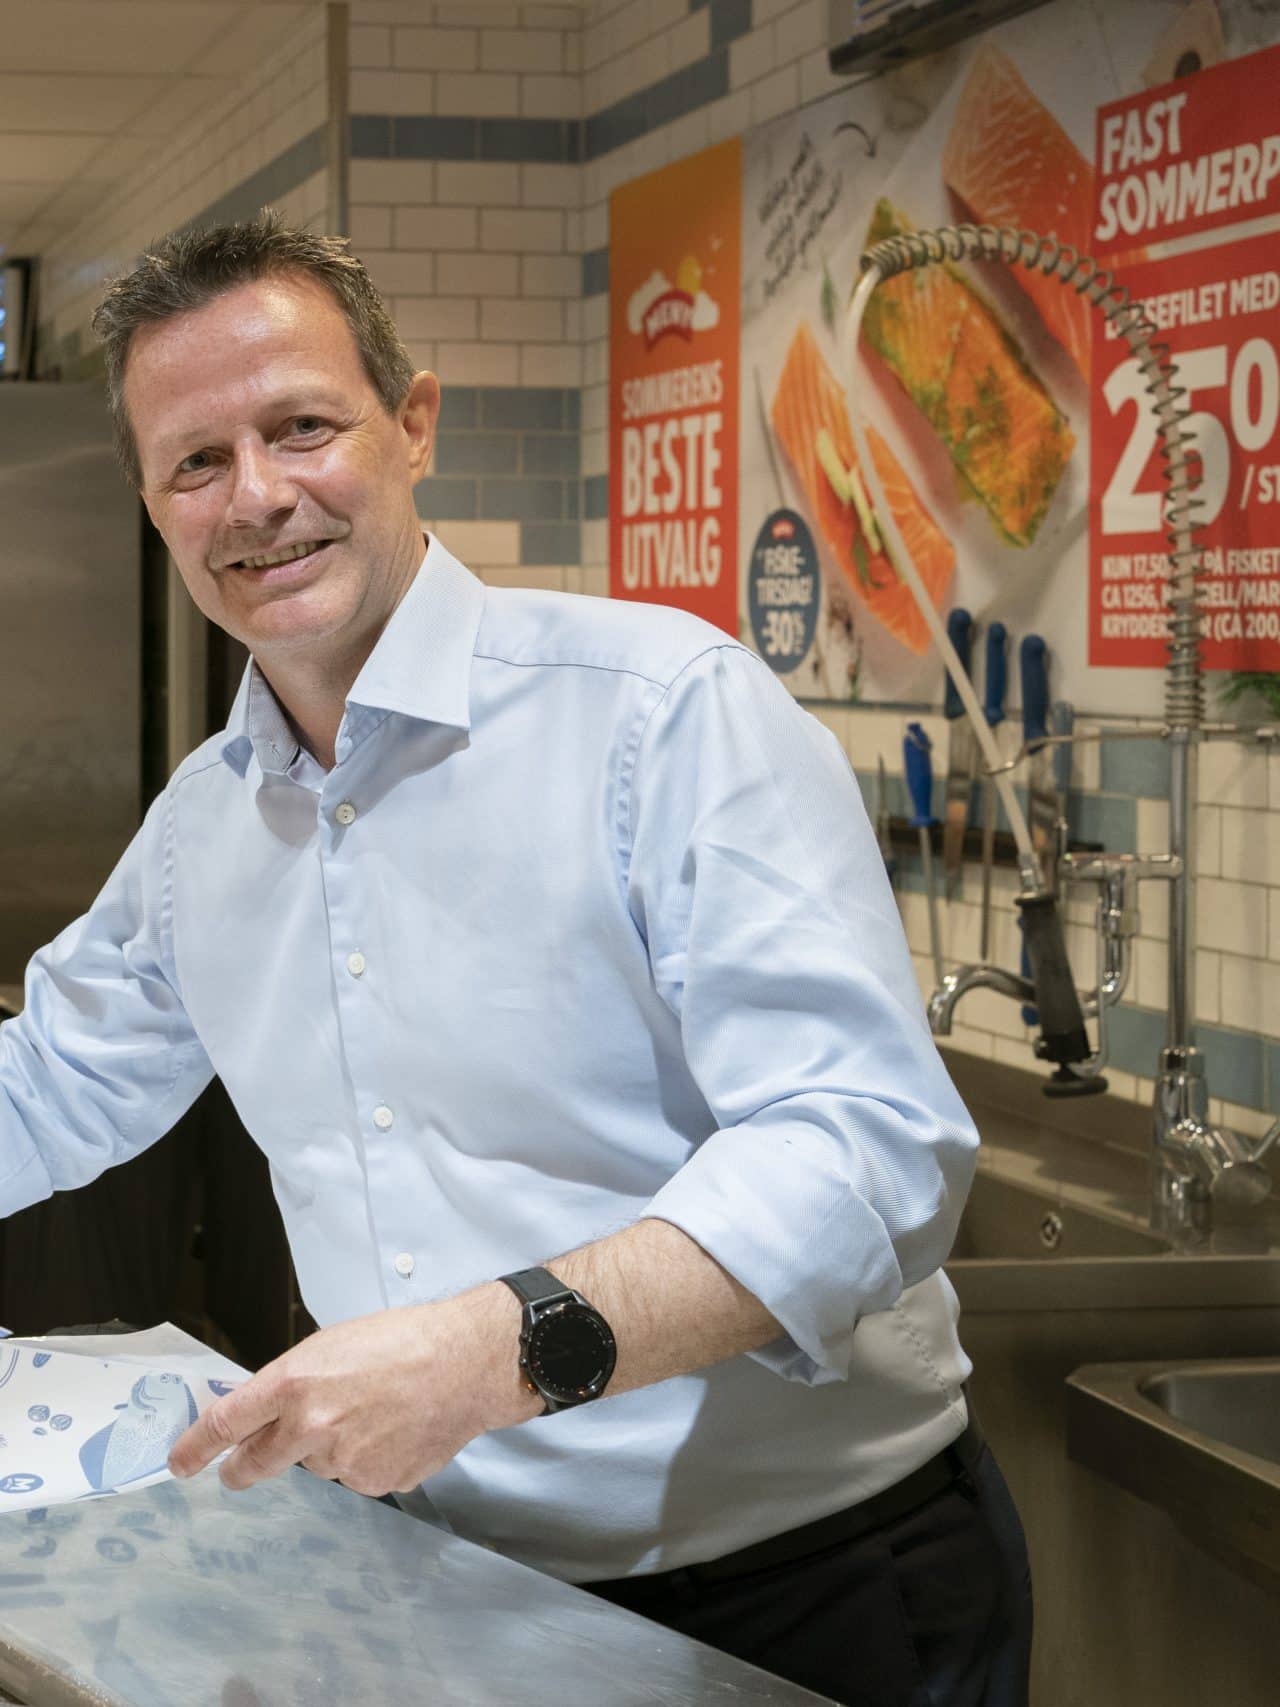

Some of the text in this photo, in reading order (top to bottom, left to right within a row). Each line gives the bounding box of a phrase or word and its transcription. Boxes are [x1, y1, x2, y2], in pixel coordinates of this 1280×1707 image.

[1102, 93, 1187, 176] FAST
[1095, 136, 1280, 241] SOMMERP
[1104, 271, 1280, 340] LSEFILET MED
[622, 359, 723, 420] SOMMERENS
[622, 411, 722, 517] BESTE
[622, 516, 722, 589] UTVALG
[1101, 554, 1132, 580] KUN
[1204, 545, 1225, 576] PÅ
[1101, 585, 1122, 609] CA
[1214, 612, 1243, 643] (CA
